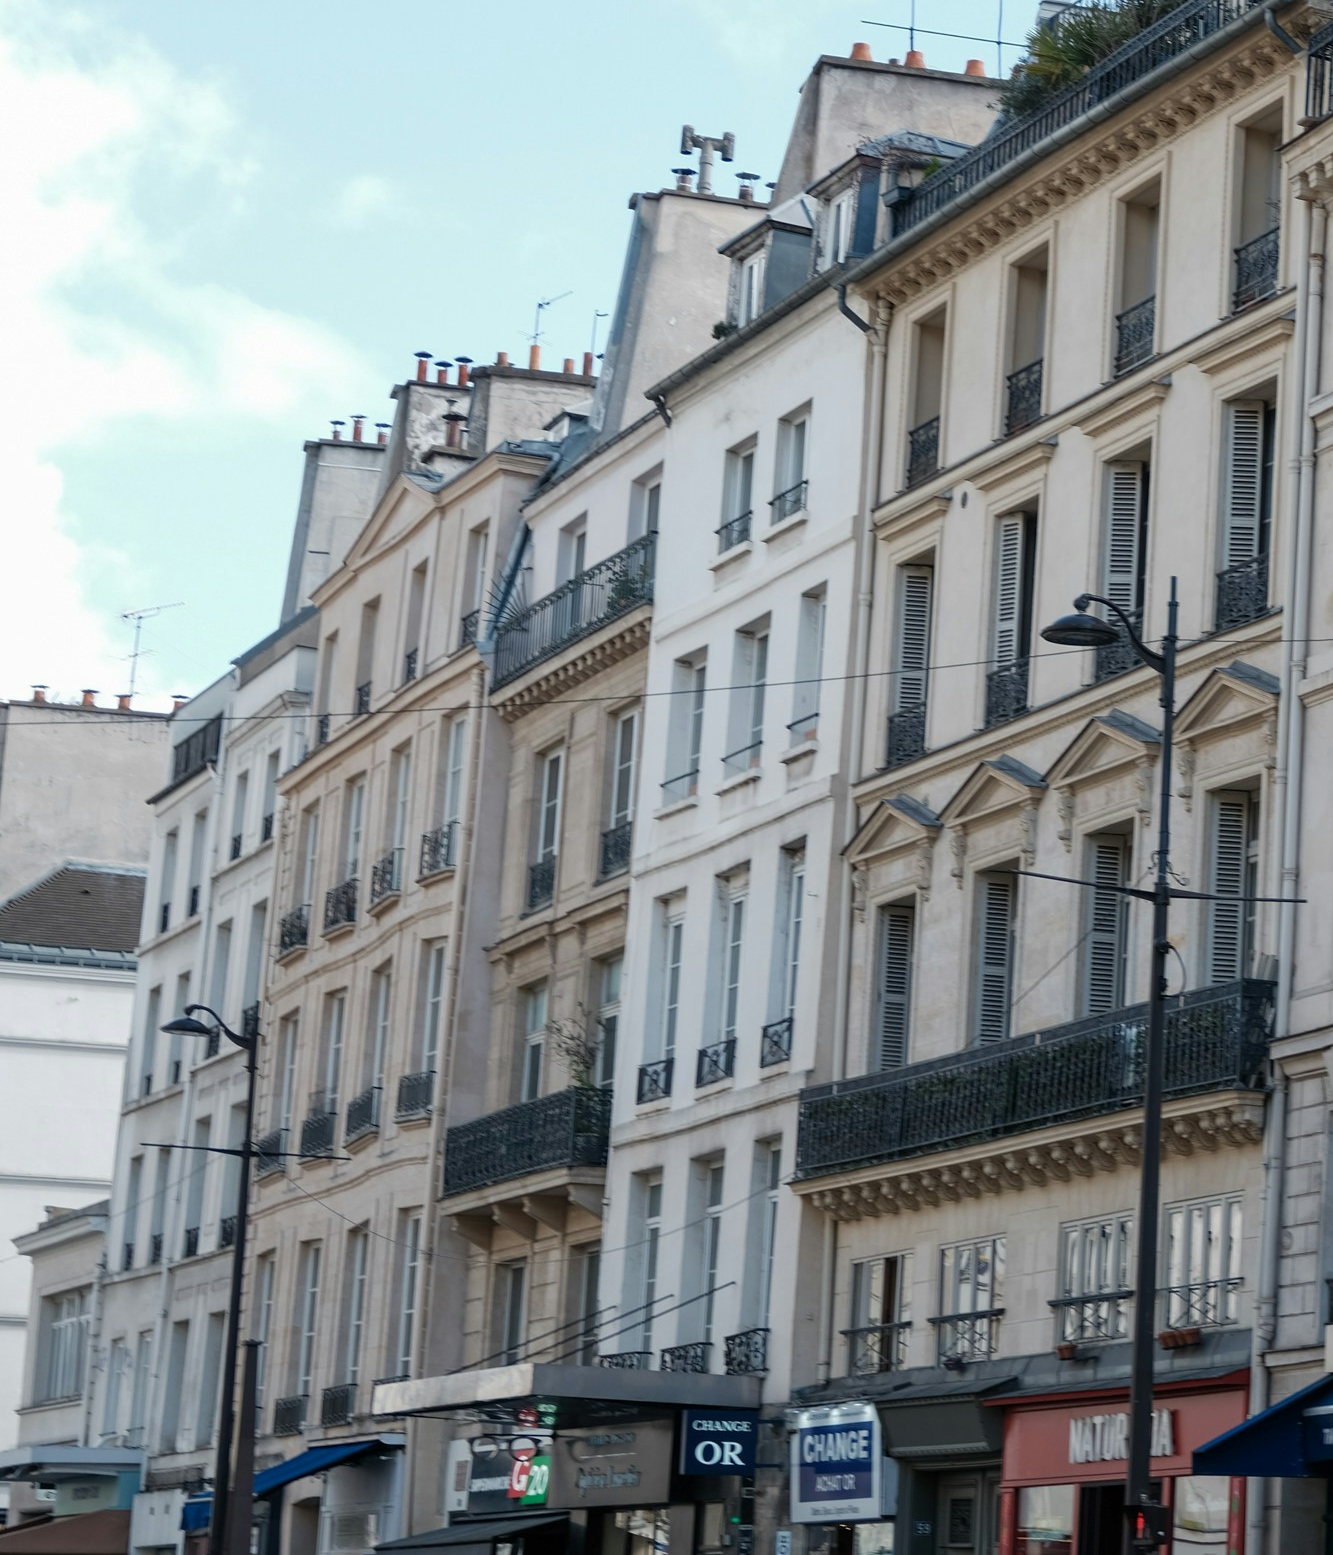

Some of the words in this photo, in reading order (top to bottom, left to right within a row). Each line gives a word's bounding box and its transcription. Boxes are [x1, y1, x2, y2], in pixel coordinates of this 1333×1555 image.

[691, 1419, 752, 1433] CHANGE
[1069, 1409, 1174, 1463] NATURIA
[694, 1440, 746, 1467] OR
[803, 1430, 869, 1463] CHANGE
[511, 1456, 530, 1492] G
[526, 1464, 549, 1496] 20
[815, 1475, 843, 1492] ACHAT
[842, 1473, 856, 1491] OR
